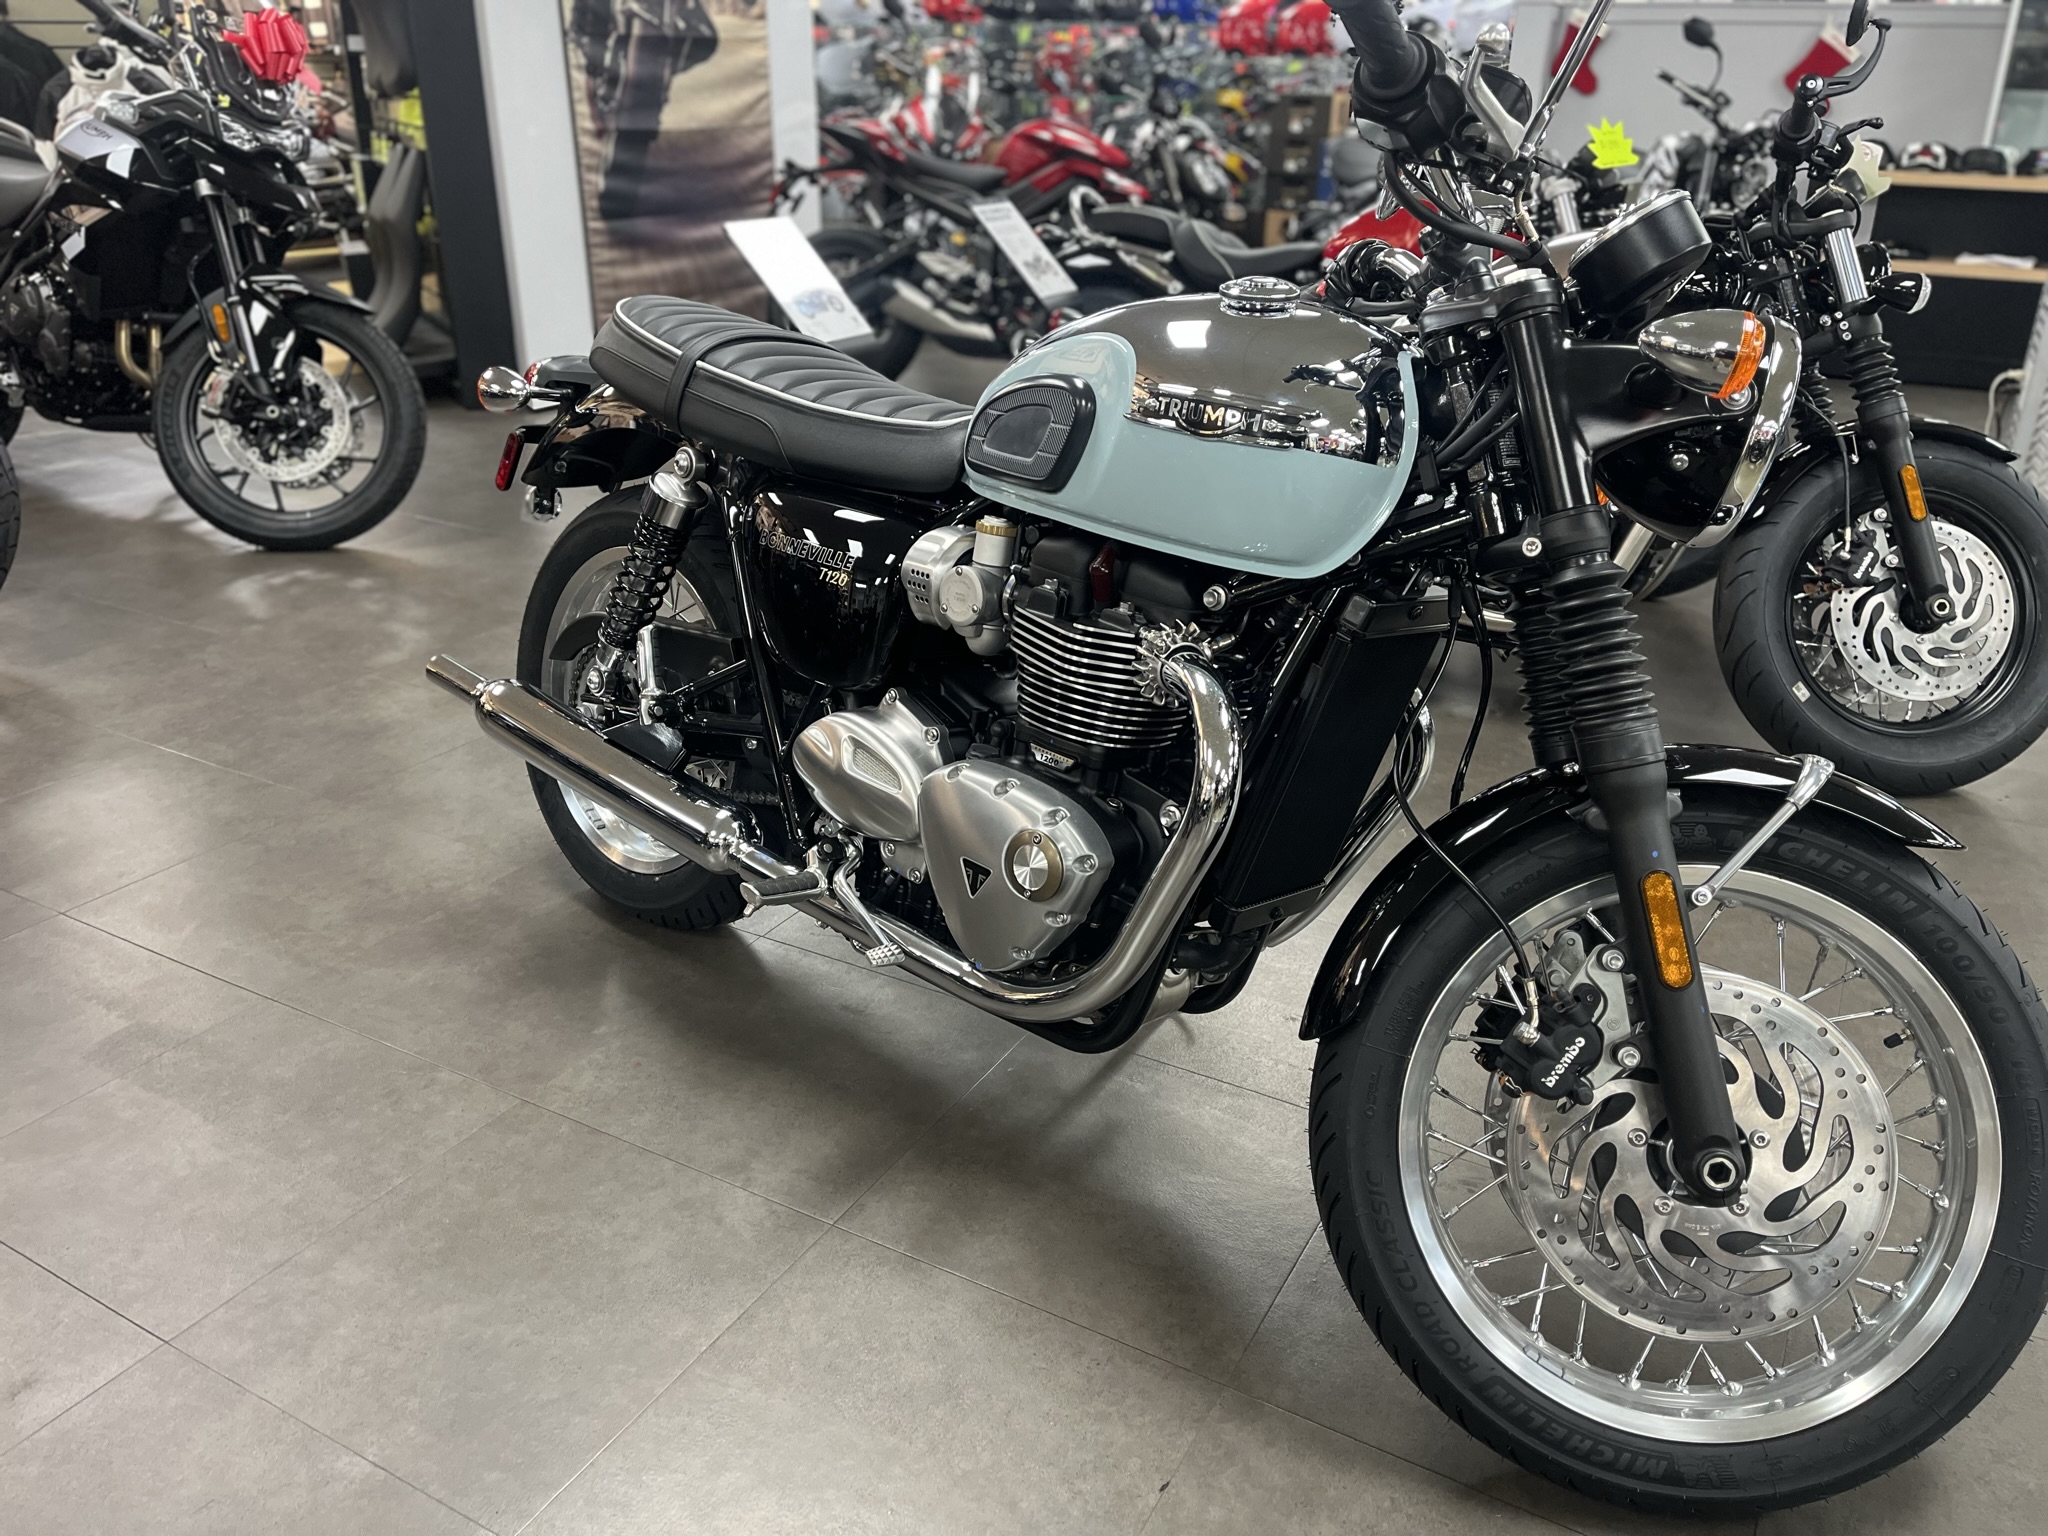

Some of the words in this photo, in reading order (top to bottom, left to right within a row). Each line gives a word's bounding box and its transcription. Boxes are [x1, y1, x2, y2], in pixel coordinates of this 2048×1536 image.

[1157, 396, 1263, 434] TRIUMPH
[758, 528, 856, 572] BONNEVILLE
[819, 566, 849, 587] T120
[1852, 551, 1874, 580] brembo
[1040, 753, 1059, 766] 1200
[1384, 984, 1415, 1037] TUBELESS
[1540, 1035, 1586, 1089] brembo
[1364, 1168, 1419, 1293] CLASSIC
[2019, 1170, 2043, 1250] ROTATION
[1413, 1301, 1479, 1376] ROAD
[1482, 1384, 1669, 1479] MICHELIN
